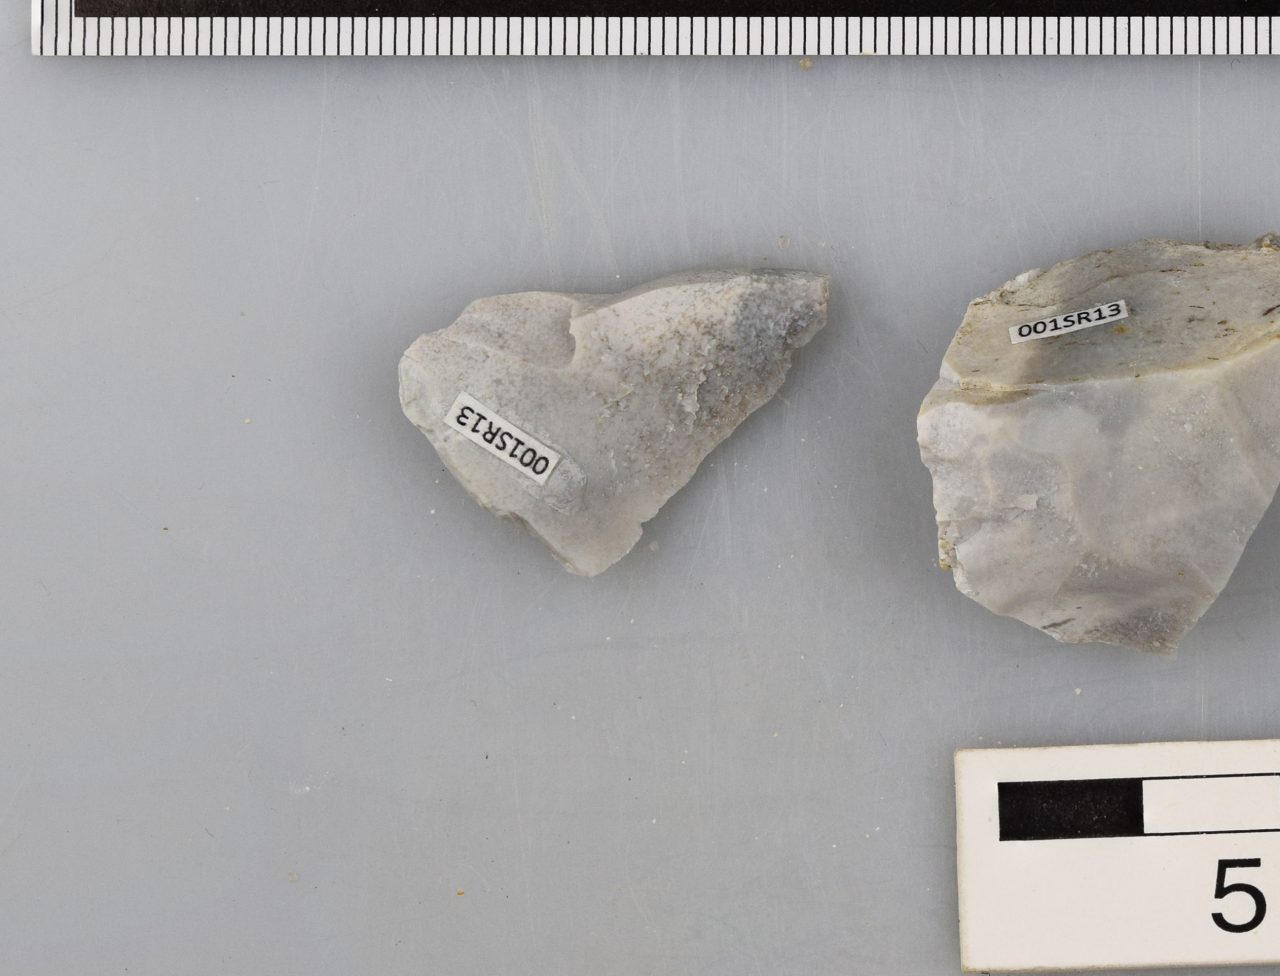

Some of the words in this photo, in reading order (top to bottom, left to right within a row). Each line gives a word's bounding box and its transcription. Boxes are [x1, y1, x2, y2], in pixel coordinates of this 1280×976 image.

[1018, 303, 1121, 337] 001SR13
[456, 406, 550, 475] 001SR13
[1211, 857, 1267, 934] 5
